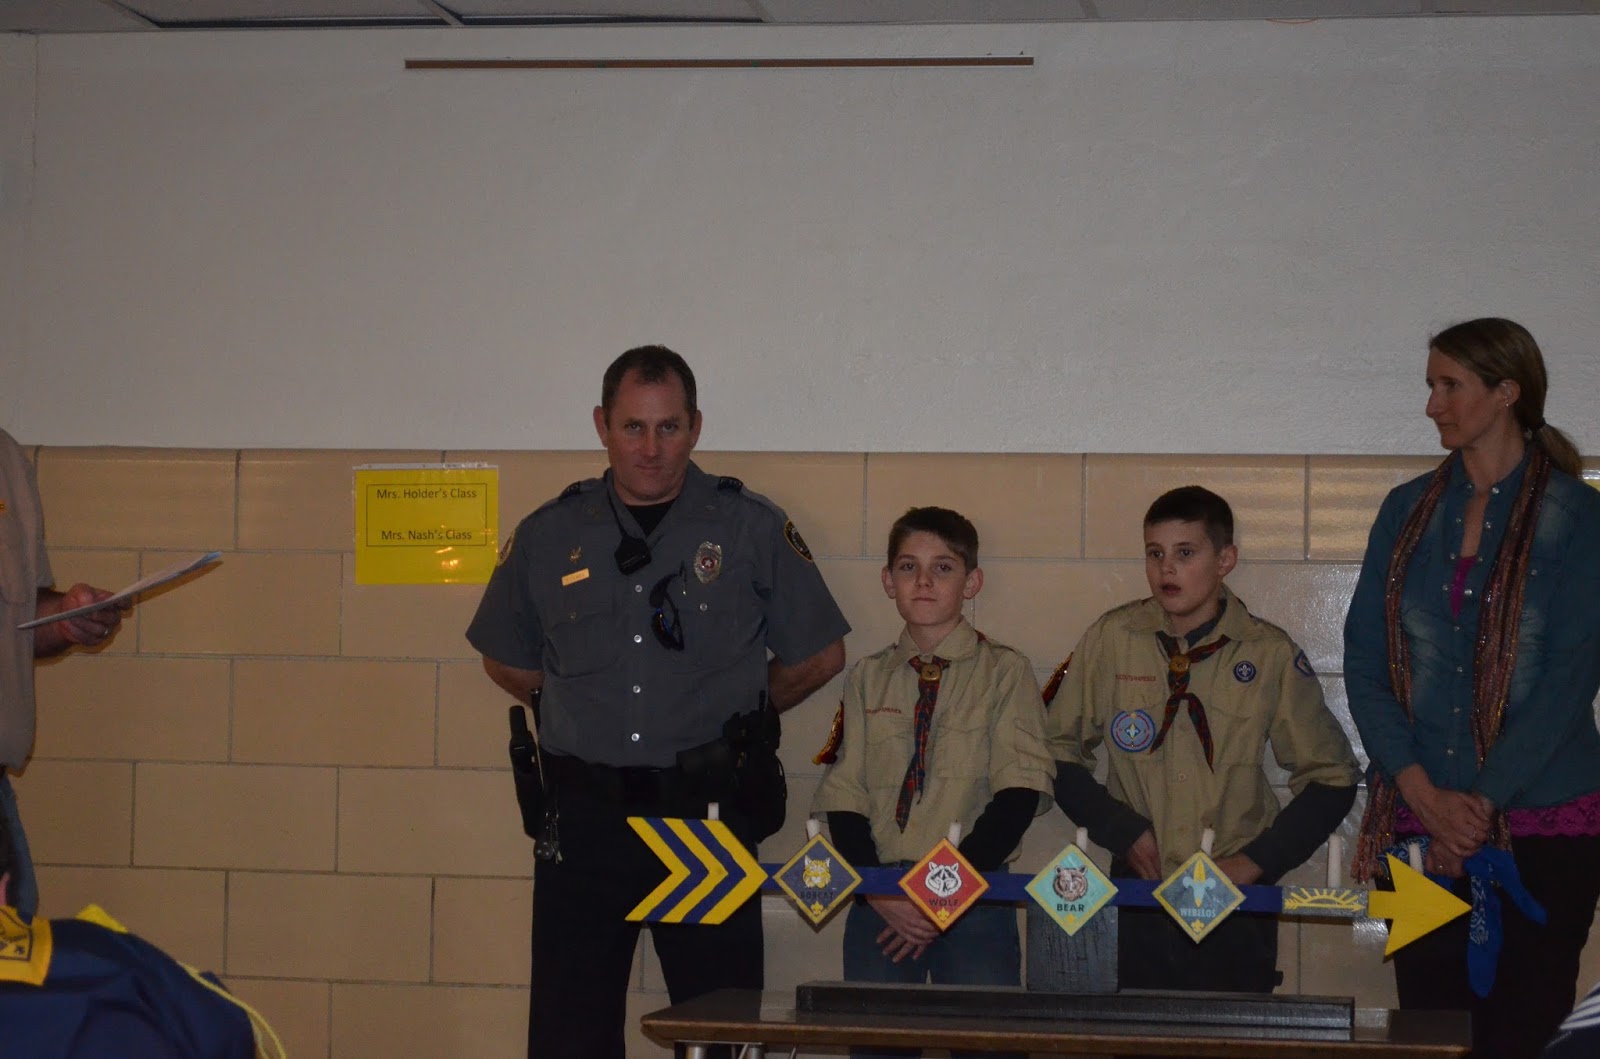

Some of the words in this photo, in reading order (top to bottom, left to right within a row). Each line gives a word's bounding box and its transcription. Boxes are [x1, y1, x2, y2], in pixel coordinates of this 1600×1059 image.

[376, 488, 400, 499] Mrs.
[403, 488, 448, 499] Holder's
[450, 488, 477, 499] Class
[381, 530, 405, 540] Mrs.
[408, 529, 443, 540] Nash's
[445, 529, 472, 540] Class
[800, 890, 835, 900] BOBCAT
[928, 898, 960, 907] WOLF
[1056, 903, 1085, 912] BEAR
[1180, 907, 1217, 918] WEBELOS
